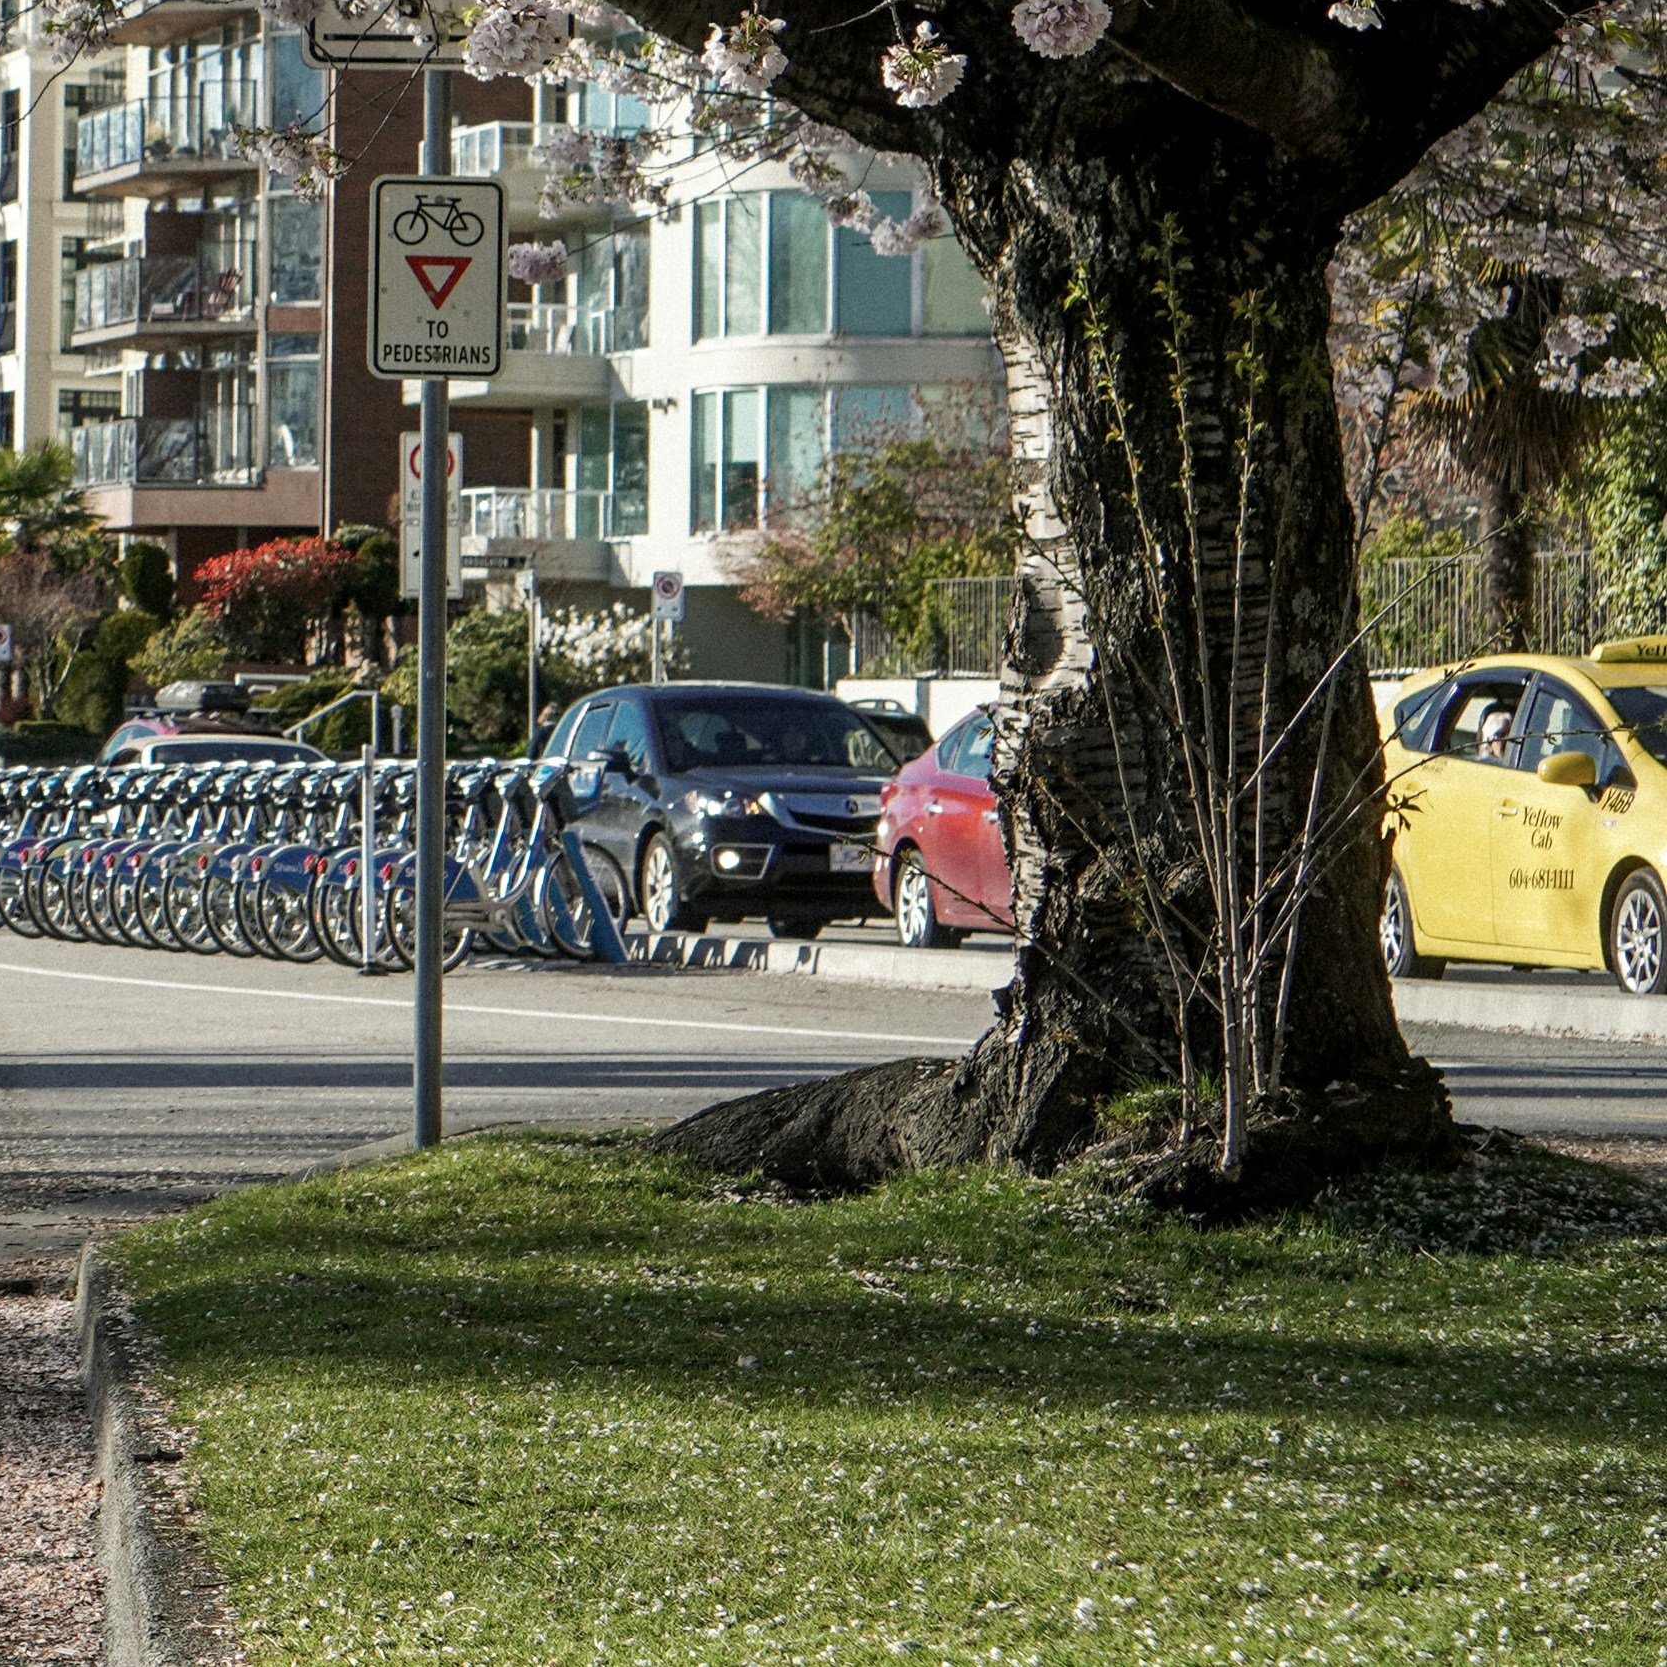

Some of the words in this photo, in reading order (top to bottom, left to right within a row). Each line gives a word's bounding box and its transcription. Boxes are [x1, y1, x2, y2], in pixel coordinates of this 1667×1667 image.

[427, 320, 449, 338] TO
[383, 344, 491, 364] PEDESTRIANS
[1522, 806, 1564, 830] Yellow
[1531, 829, 1553, 850] Cab
[1509, 868, 1575, 890] 604-681-1111
